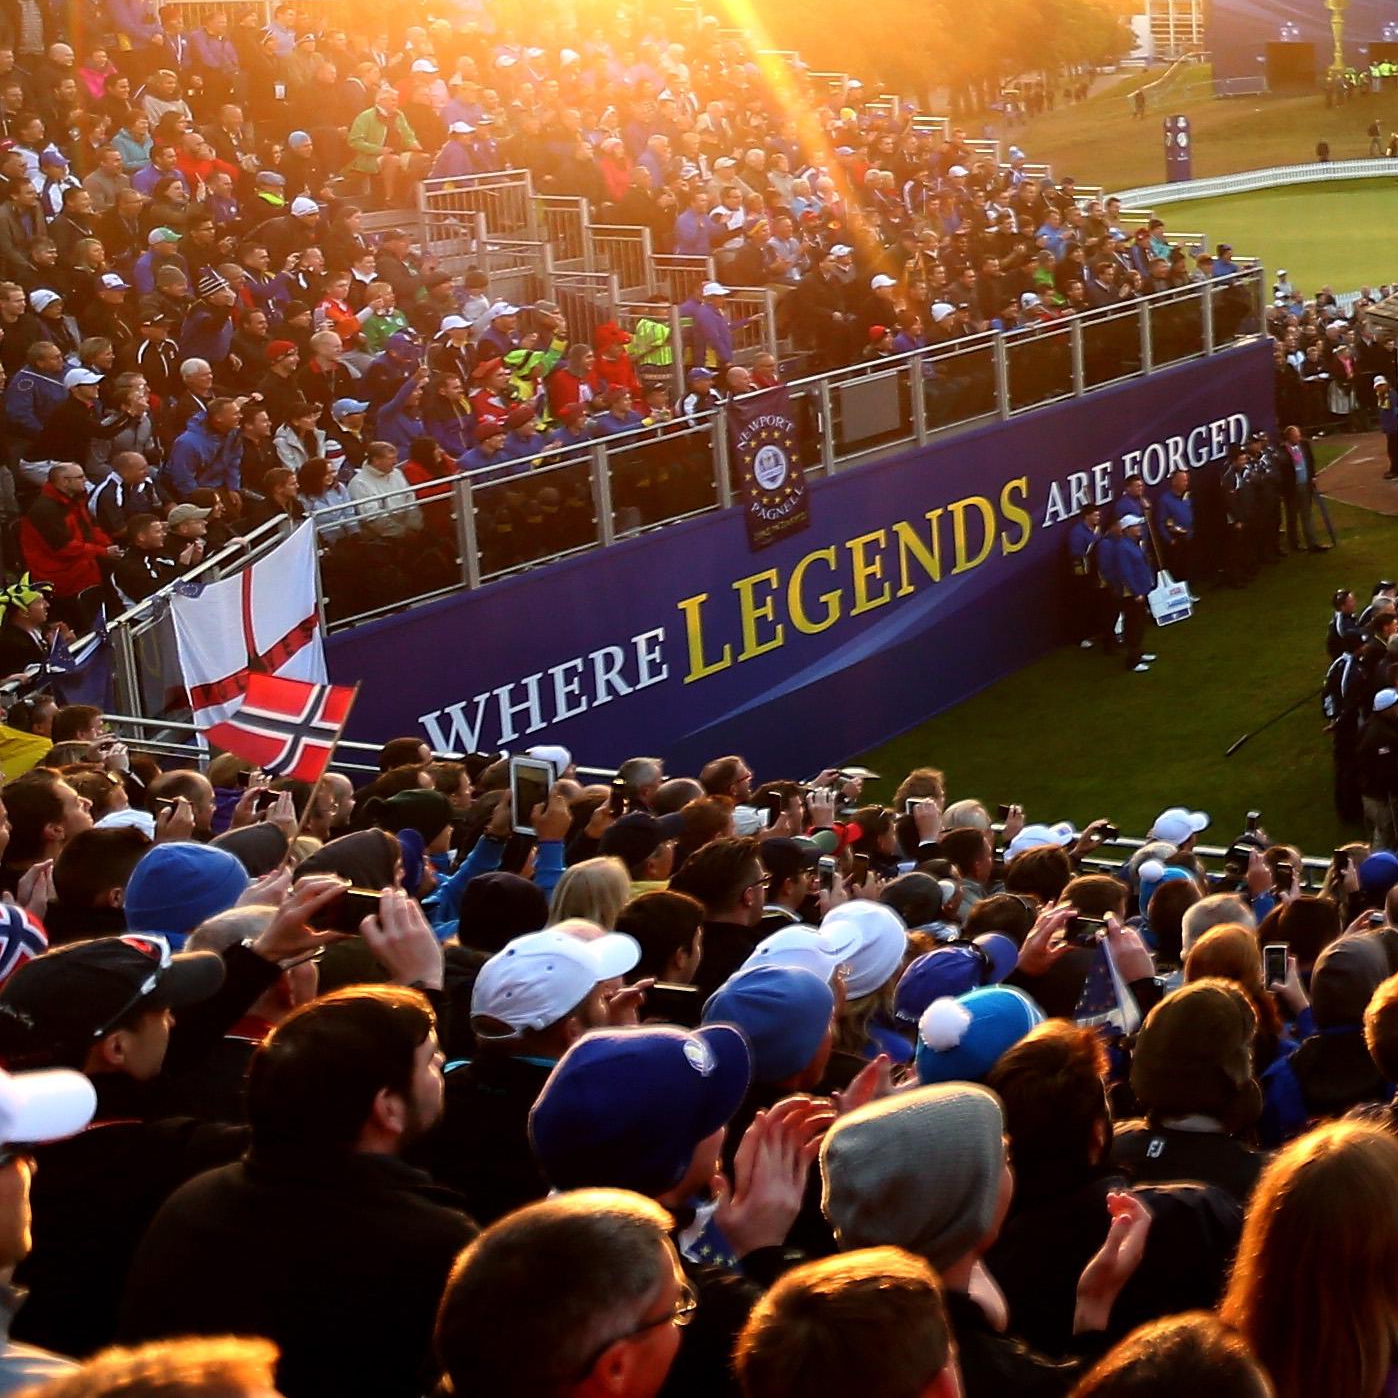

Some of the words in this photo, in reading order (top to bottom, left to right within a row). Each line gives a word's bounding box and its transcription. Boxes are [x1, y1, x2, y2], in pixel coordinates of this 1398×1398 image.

[737, 415, 795, 450] NEWPORT
[751, 486, 804, 520] PAGNELL
[418, 627, 668, 756] WHERE
[677, 476, 1032, 684] LEGENDS
[1041, 461, 1113, 528] ARE
[1121, 413, 1250, 485] FORGED
